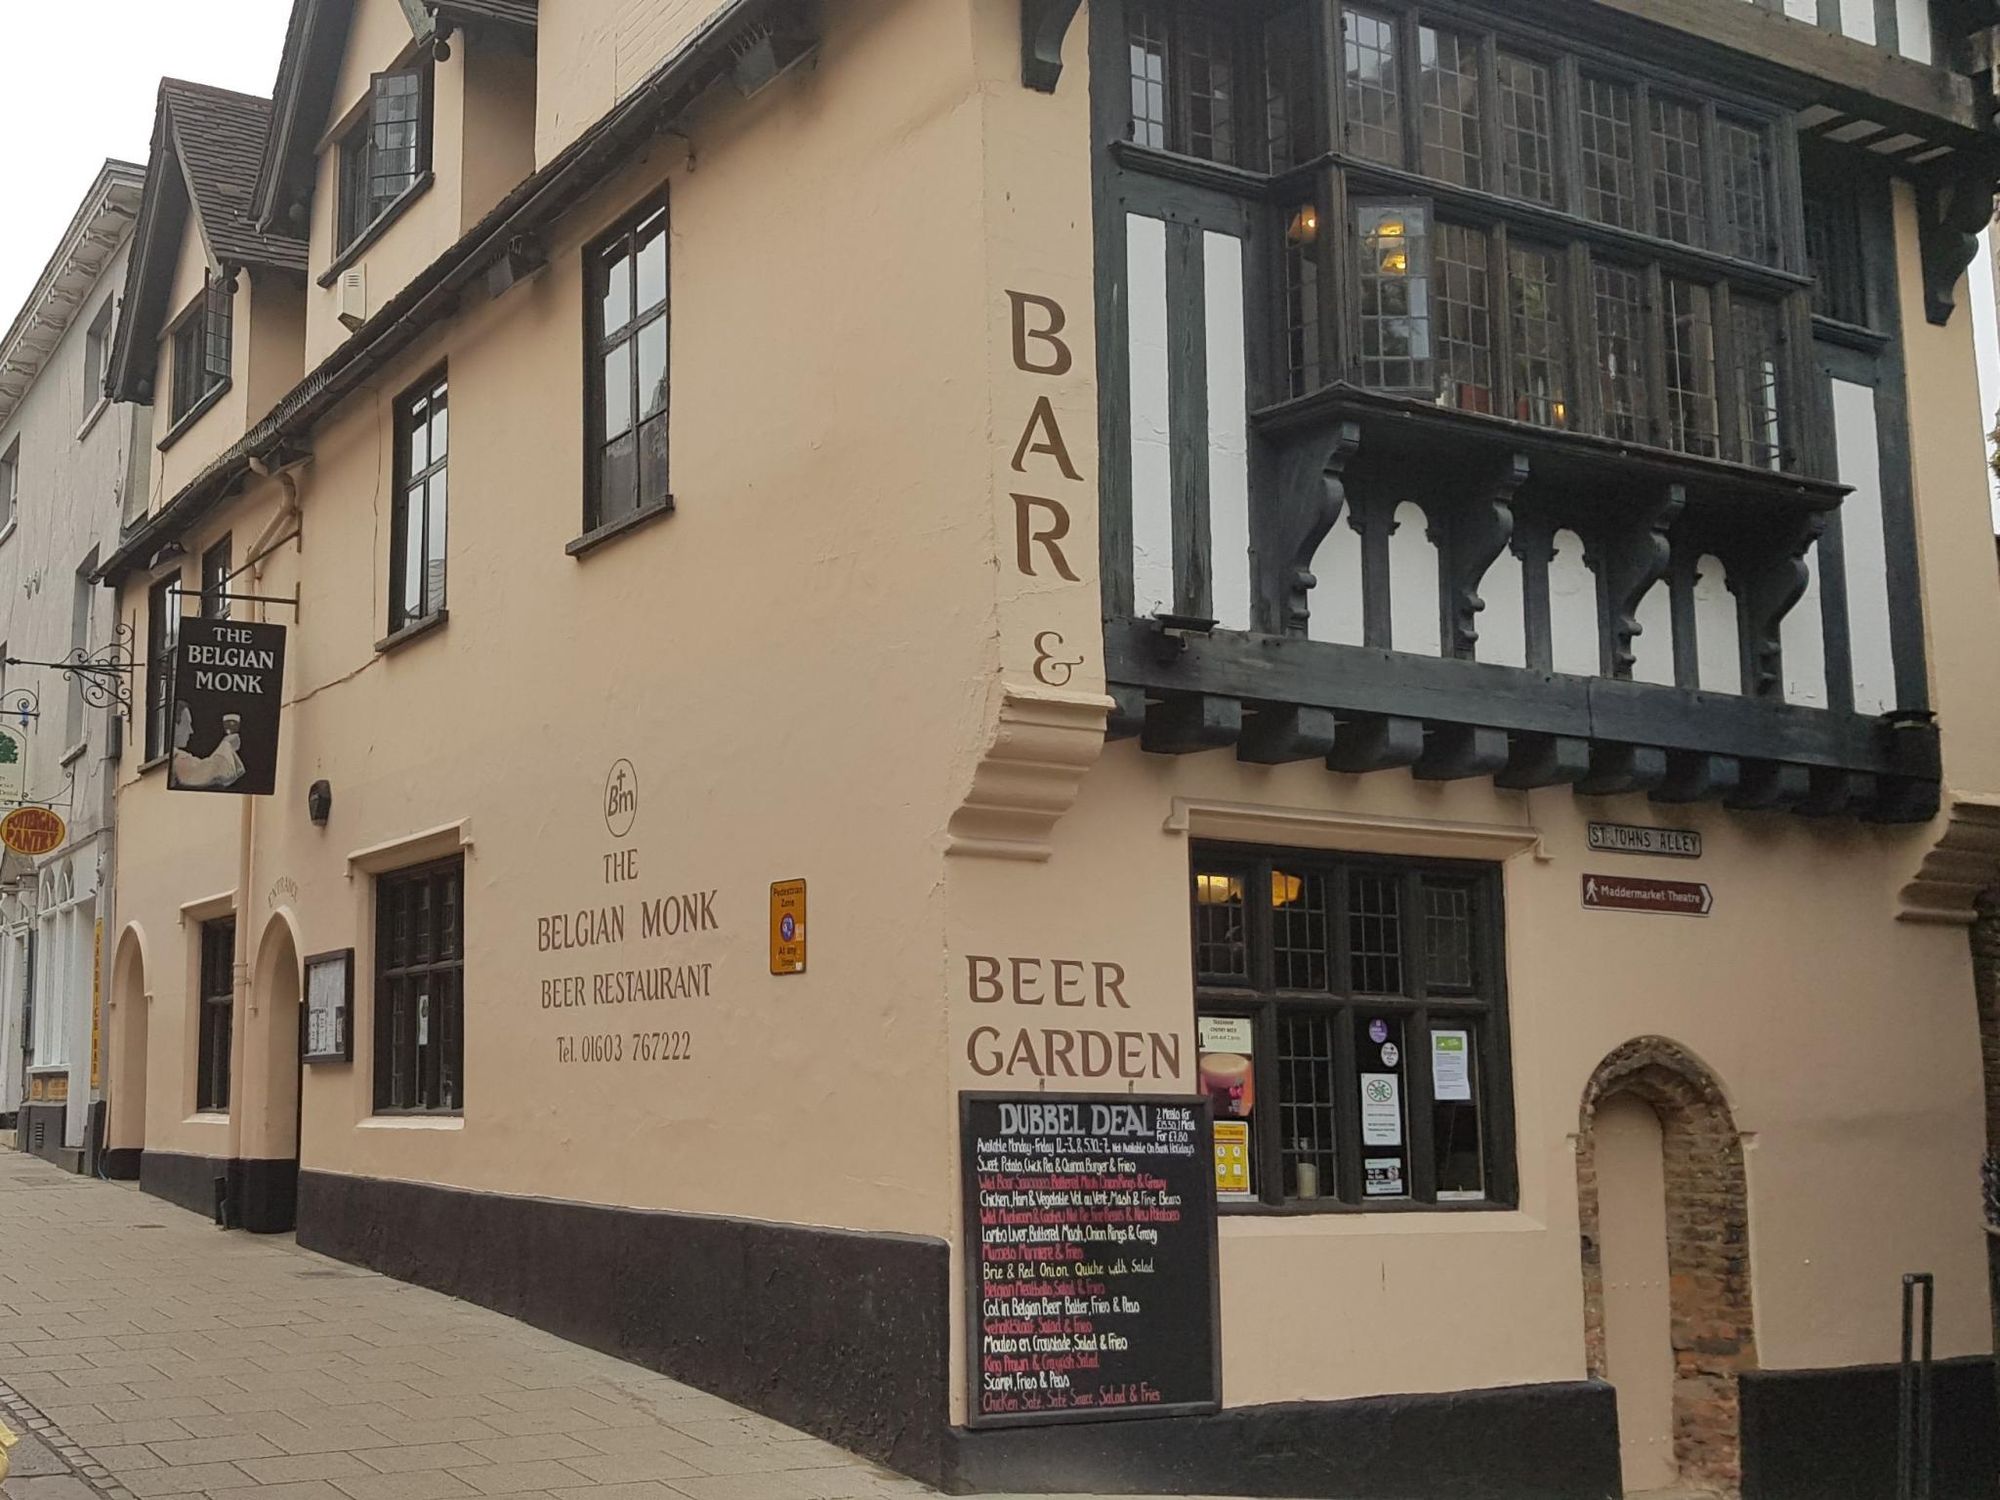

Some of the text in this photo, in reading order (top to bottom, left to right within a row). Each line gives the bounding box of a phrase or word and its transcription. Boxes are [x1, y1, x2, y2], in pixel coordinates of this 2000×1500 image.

[1004, 289, 1084, 686] BAR &
[212, 626, 253, 644] THE
[188, 645, 274, 671] BELGIAN
[195, 670, 264, 695] MONK
[1610, 827, 1651, 848] JOHNS
[1660, 834, 1697, 852] ALLEY
[604, 848, 639, 884] THE
[1600, 885, 1701, 904] Maddermarket Theatre
[537, 890, 719, 952] BELGIAN MONK
[541, 963, 712, 1010] BEER RESTAURANT
[966, 955, 1131, 1008] BEER
[557, 1031, 692, 1063] Tel. 01603 767222
[966, 1026, 1180, 1078] GARDEN
[998, 1103, 1155, 1136] DUBBEL DEAL
[1156, 1108, 1162, 1120] 2
[977, 1138, 1007, 1152] Available
[1123, 1142, 1146, 1153] Available
[1155, 1143, 1168, 1154] Bank
[1170, 1143, 1194, 1156] Holidays
[1156, 1131, 1168, 1142] For
[977, 1155, 999, 1172] Sweet
[1043, 1157, 1054, 1172] Pea
[1055, 1157, 1061, 1172] &
[1086, 1158, 1110, 1175] Burger
[1110, 1158, 1116, 1172] &
[1118, 1157, 1136, 1172] Fries
[1137, 1174, 1144, 1189] &
[1145, 1174, 1166, 1191] Gravy
[1013, 1191, 1028, 1206] Ham
[1028, 1190, 1036, 1206] &
[1036, 1190, 1069, 1209] Vegetable
[1133, 1192, 1140, 1205] &
[1141, 1192, 1157, 1206] Fine
[1158, 1192, 1181, 1205] Beans
[1126, 1208, 1133, 1221] &
[1029, 1225, 1060, 1242] Buttered
[1086, 1226, 1106, 1240] Onion
[1108, 1224, 1127, 1244] Rings
[1128, 1226, 1136, 1240] &
[1136, 1224, 1157, 1244] Gravy
[1055, 1244, 1064, 1260] &
[1066, 1244, 1084, 1260] Fries
[984, 1258, 1154, 1279] Brie & Red Onion Quiche with Salad
[984, 1298, 999, 1316] Cod
[1001, 1300, 1009, 1316] in
[1012, 1298, 1041, 1320] Belgian
[1042, 1297, 1062, 1315] Beer
[1092, 1296, 1110, 1314] Fries
[1113, 1296, 1120, 1312] &
[1123, 1296, 1140, 1313] Peas
[1064, 1317, 1072, 1332] &
[984, 1335, 1016, 1352] Moules
[1019, 1339, 1031, 1352] en
[1074, 1334, 1098, 1350] Salad
[1100, 1334, 1107, 1350] &
[1109, 1333, 1128, 1350] Fries
[984, 1355, 1001, 1376] King
[1004, 1354, 1028, 1370] Prawn
[1032, 1354, 1040, 1370] &
[1077, 1352, 1099, 1368] Salad
[1017, 1372, 1037, 1390] Fries
[1040, 1372, 1048, 1388] &
[1050, 1370, 1070, 1388] Peas
[984, 1392, 1017, 1411] Chicken
[1099, 1384, 1126, 1406] Salad
[1130, 1384, 1137, 1402] &
[1140, 1382, 1160, 1402] Fries
